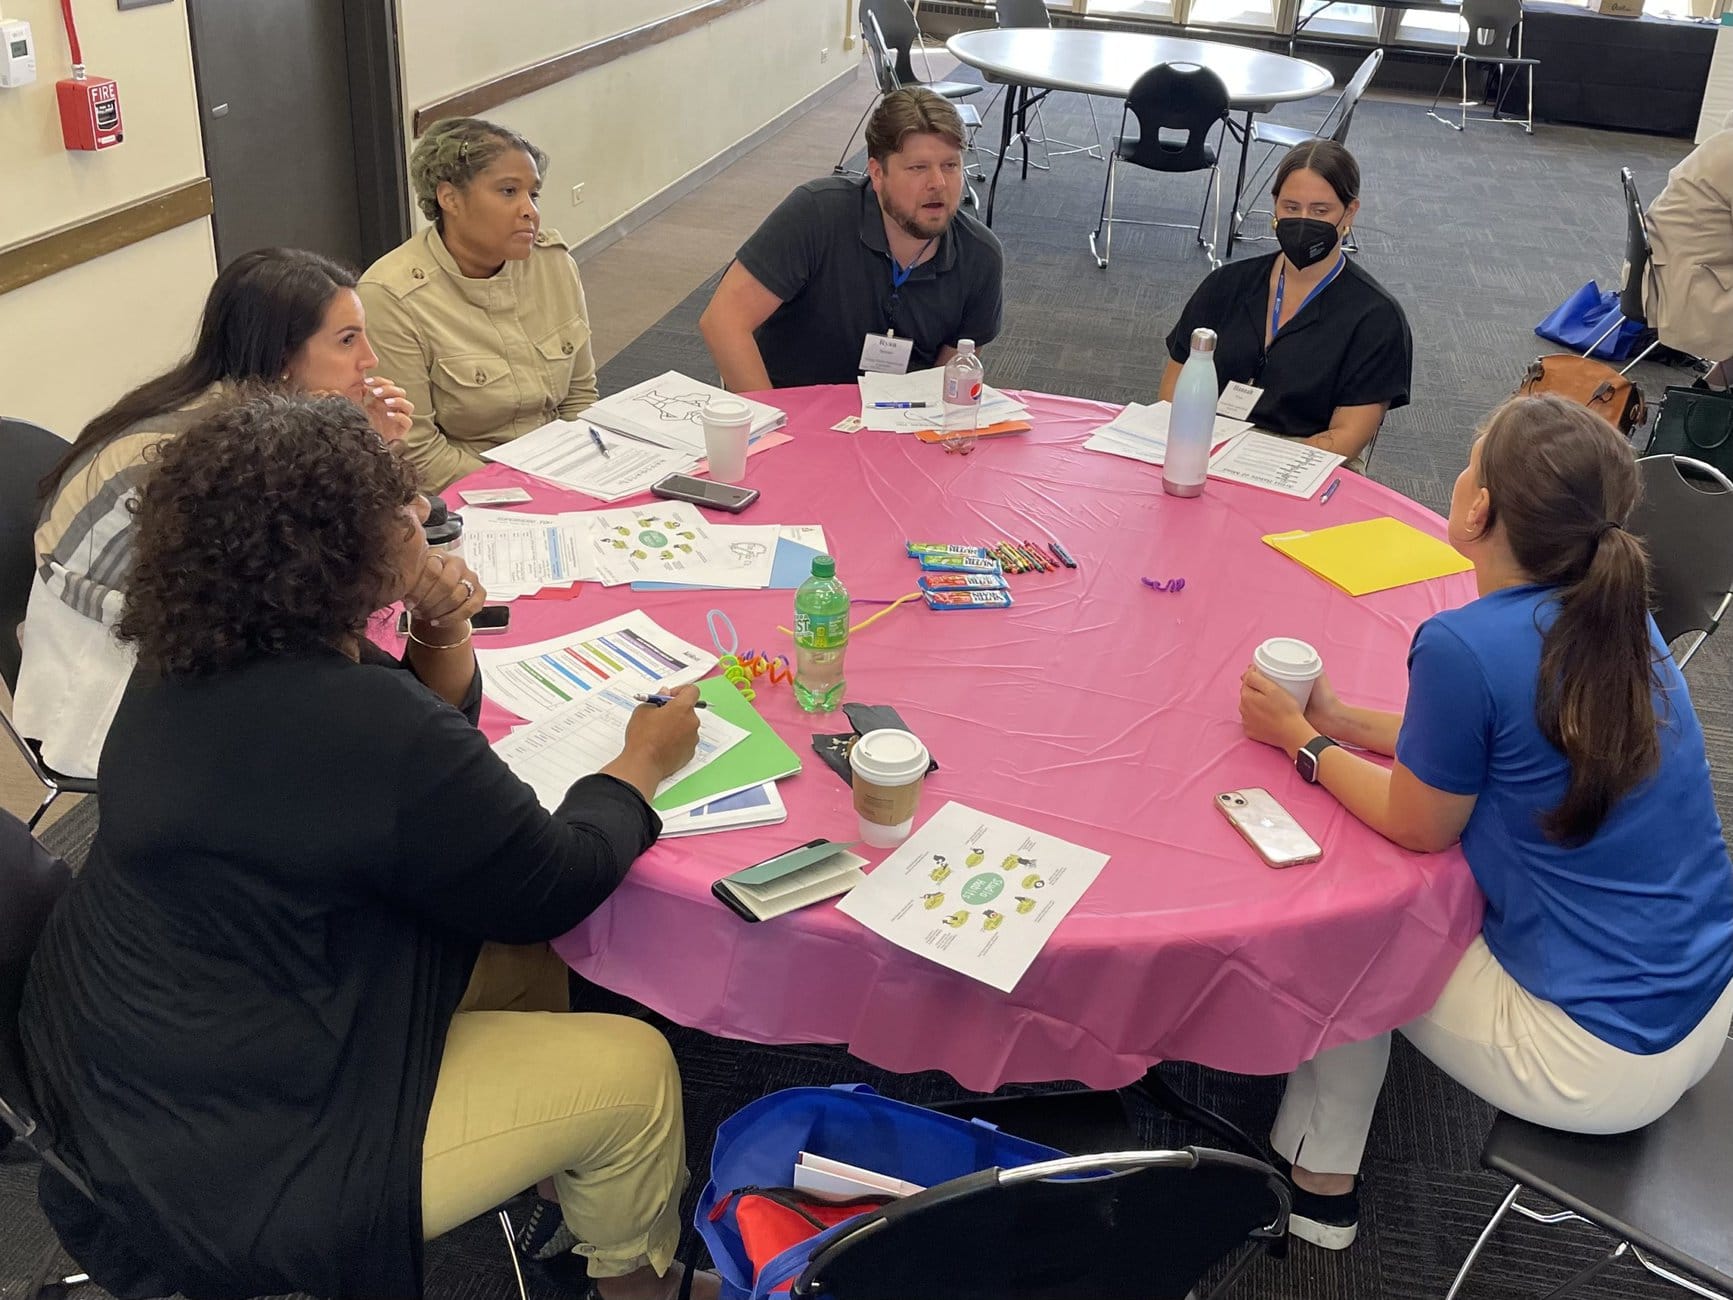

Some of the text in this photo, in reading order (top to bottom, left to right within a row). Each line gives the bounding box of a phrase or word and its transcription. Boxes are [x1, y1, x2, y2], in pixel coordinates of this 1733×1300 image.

[91, 84, 116, 101] FIRE
[879, 339, 897, 348] Ryan
[965, 557, 993, 567] NUTRI
[963, 878, 985, 899] Habits
[979, 878, 1002, 897] Studio
